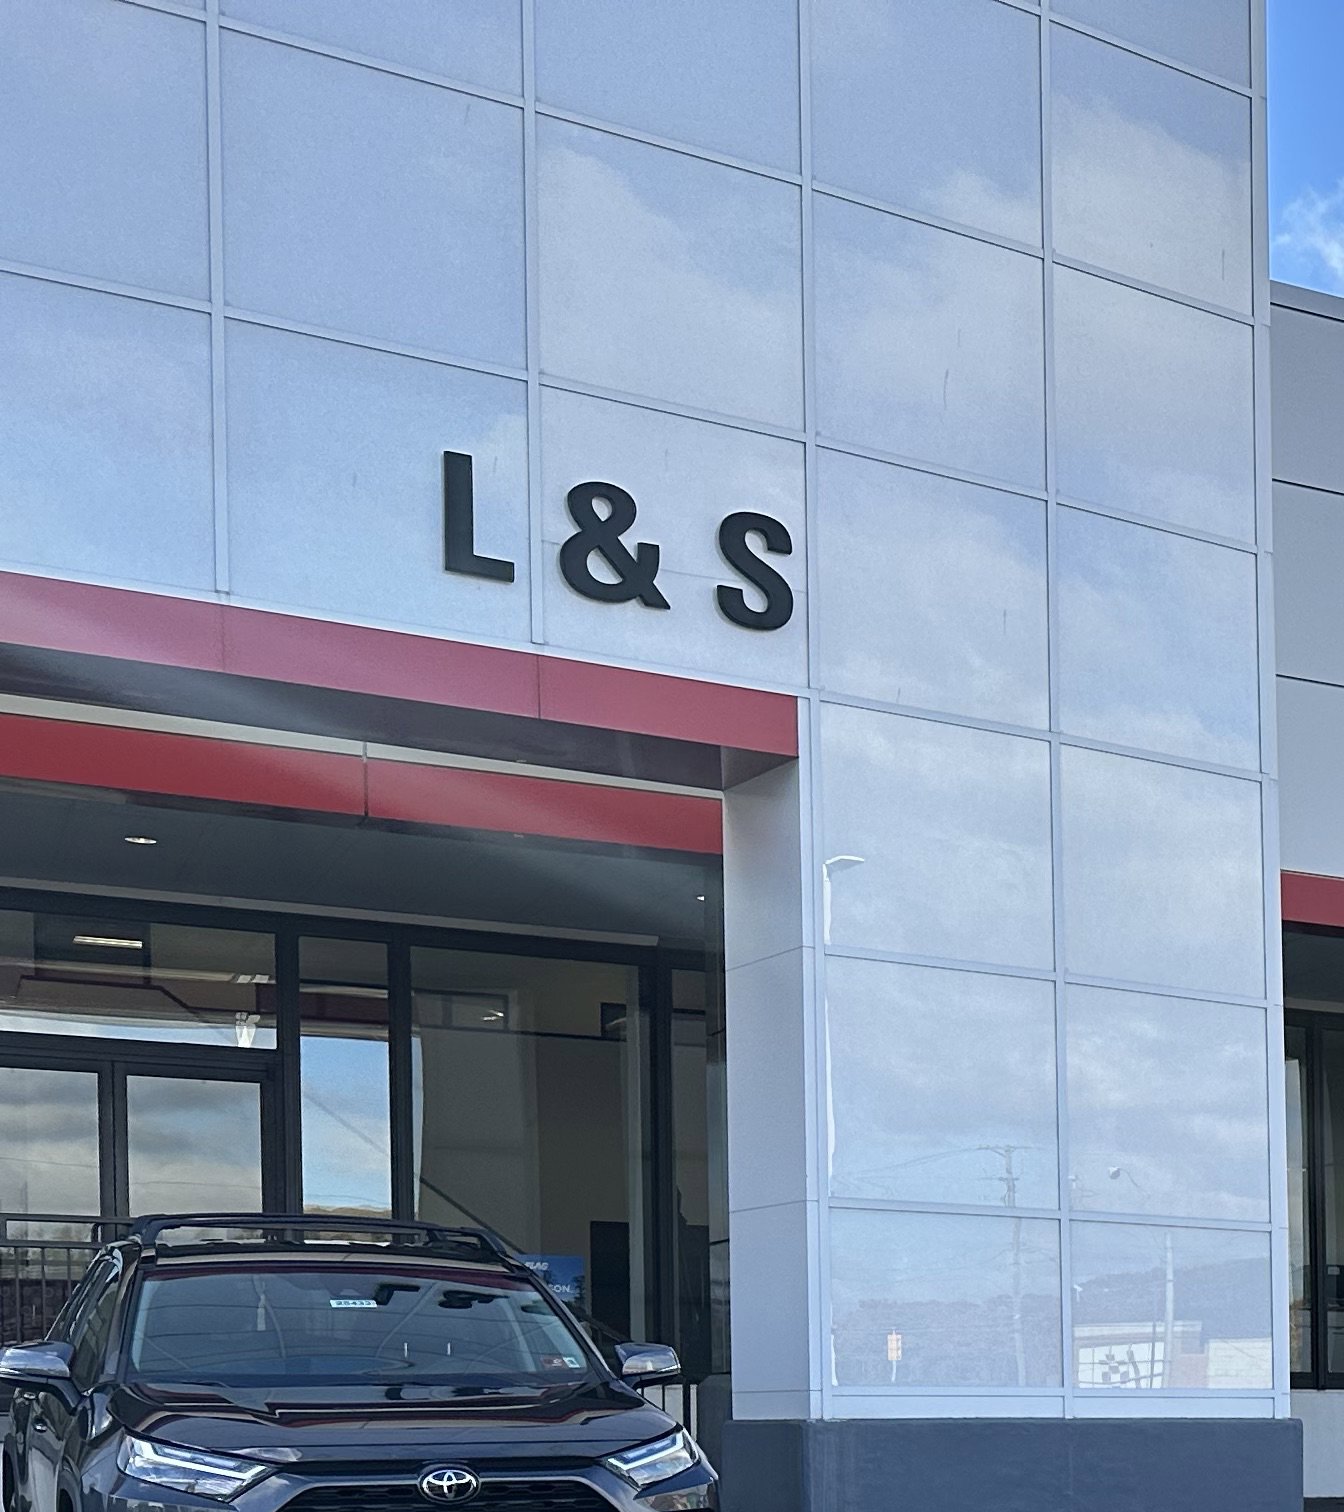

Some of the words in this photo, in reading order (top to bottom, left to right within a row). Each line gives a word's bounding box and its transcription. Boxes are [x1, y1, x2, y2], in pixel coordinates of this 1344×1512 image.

[443, 450, 515, 582] L
[559, 481, 671, 610] &
[715, 511, 794, 631] S
